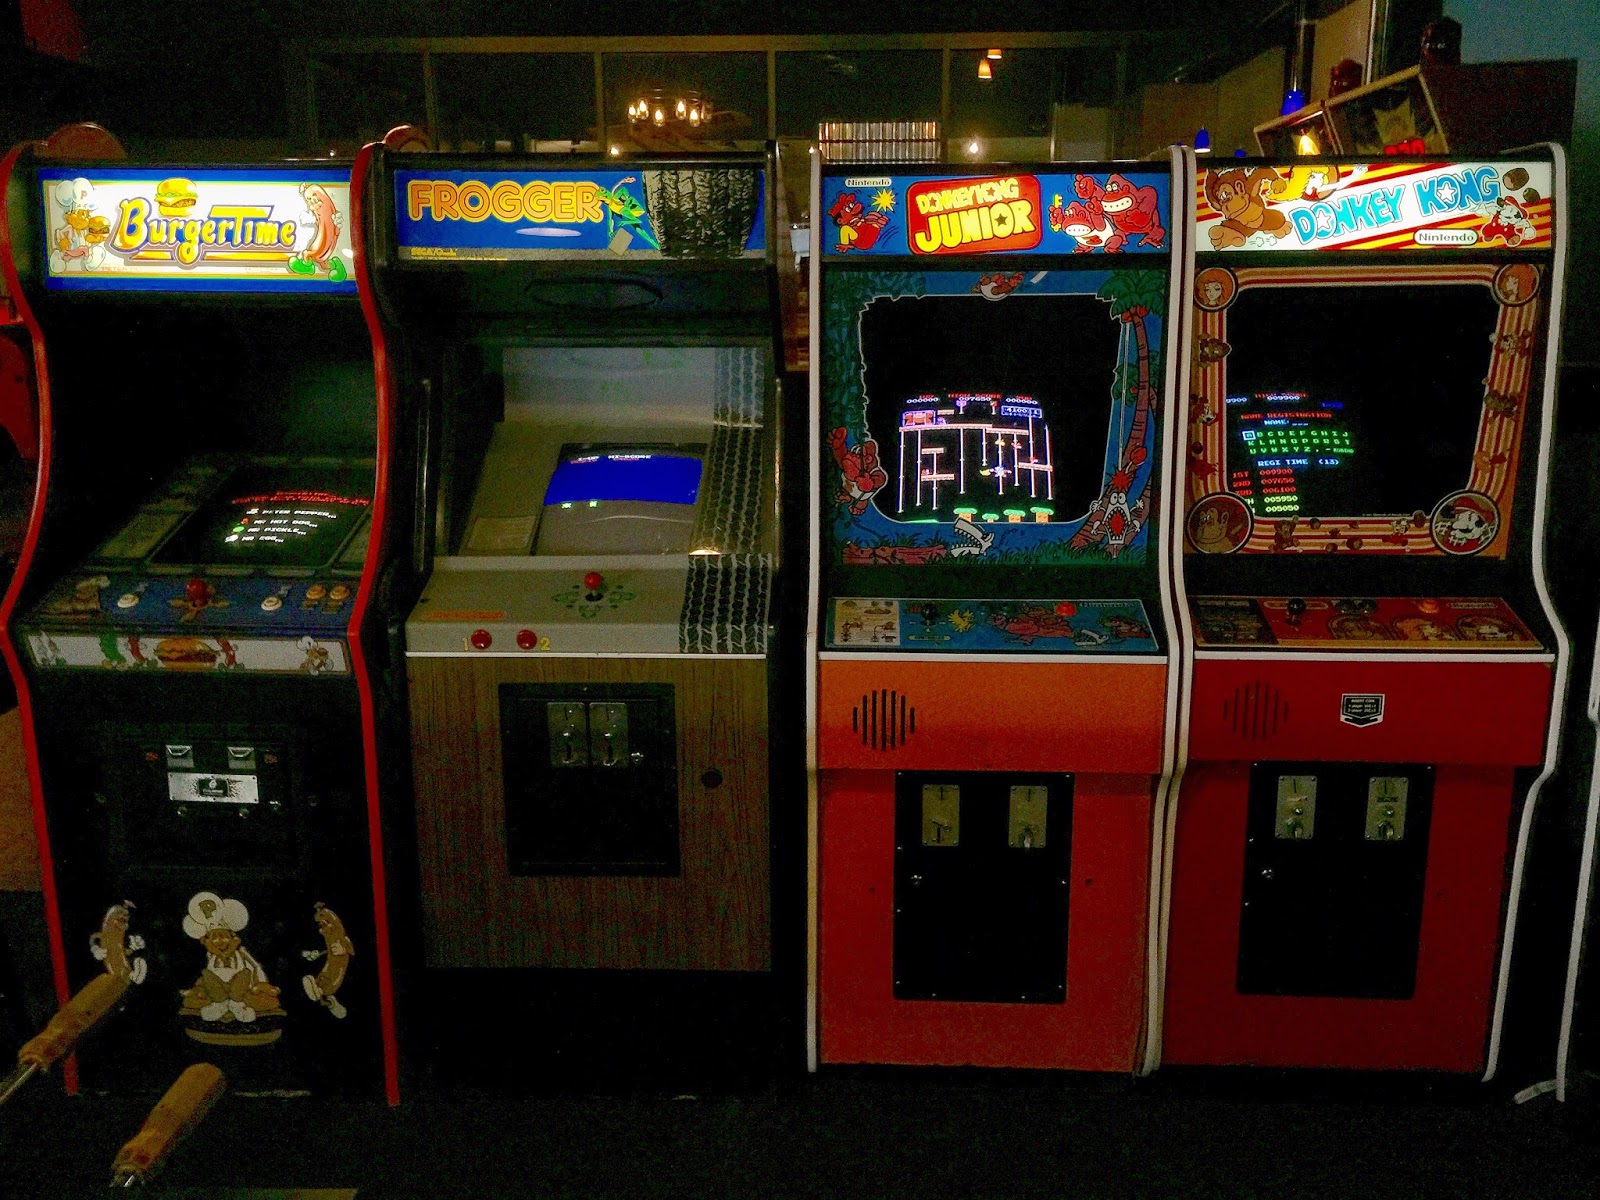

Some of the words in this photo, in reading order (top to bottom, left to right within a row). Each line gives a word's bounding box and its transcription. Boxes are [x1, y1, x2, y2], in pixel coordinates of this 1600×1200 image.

[408, 179, 603, 223] FROGGER
[916, 183, 976, 214] DONKEY
[975, 177, 1019, 205] KONG
[1289, 184, 1405, 245] DONKEY
[1414, 166, 1501, 217] KONG
[913, 199, 1034, 253] JUNIOR
[1419, 232, 1475, 242] Nintendo
[1257, 459, 1281, 467] REGI
[1261, 477, 1295, 485] 007650
[1262, 486, 1297, 494] 006100
[1264, 495, 1298, 503] 005950
[461, 637, 469, 652] 1
[540, 637, 550, 652] 2
